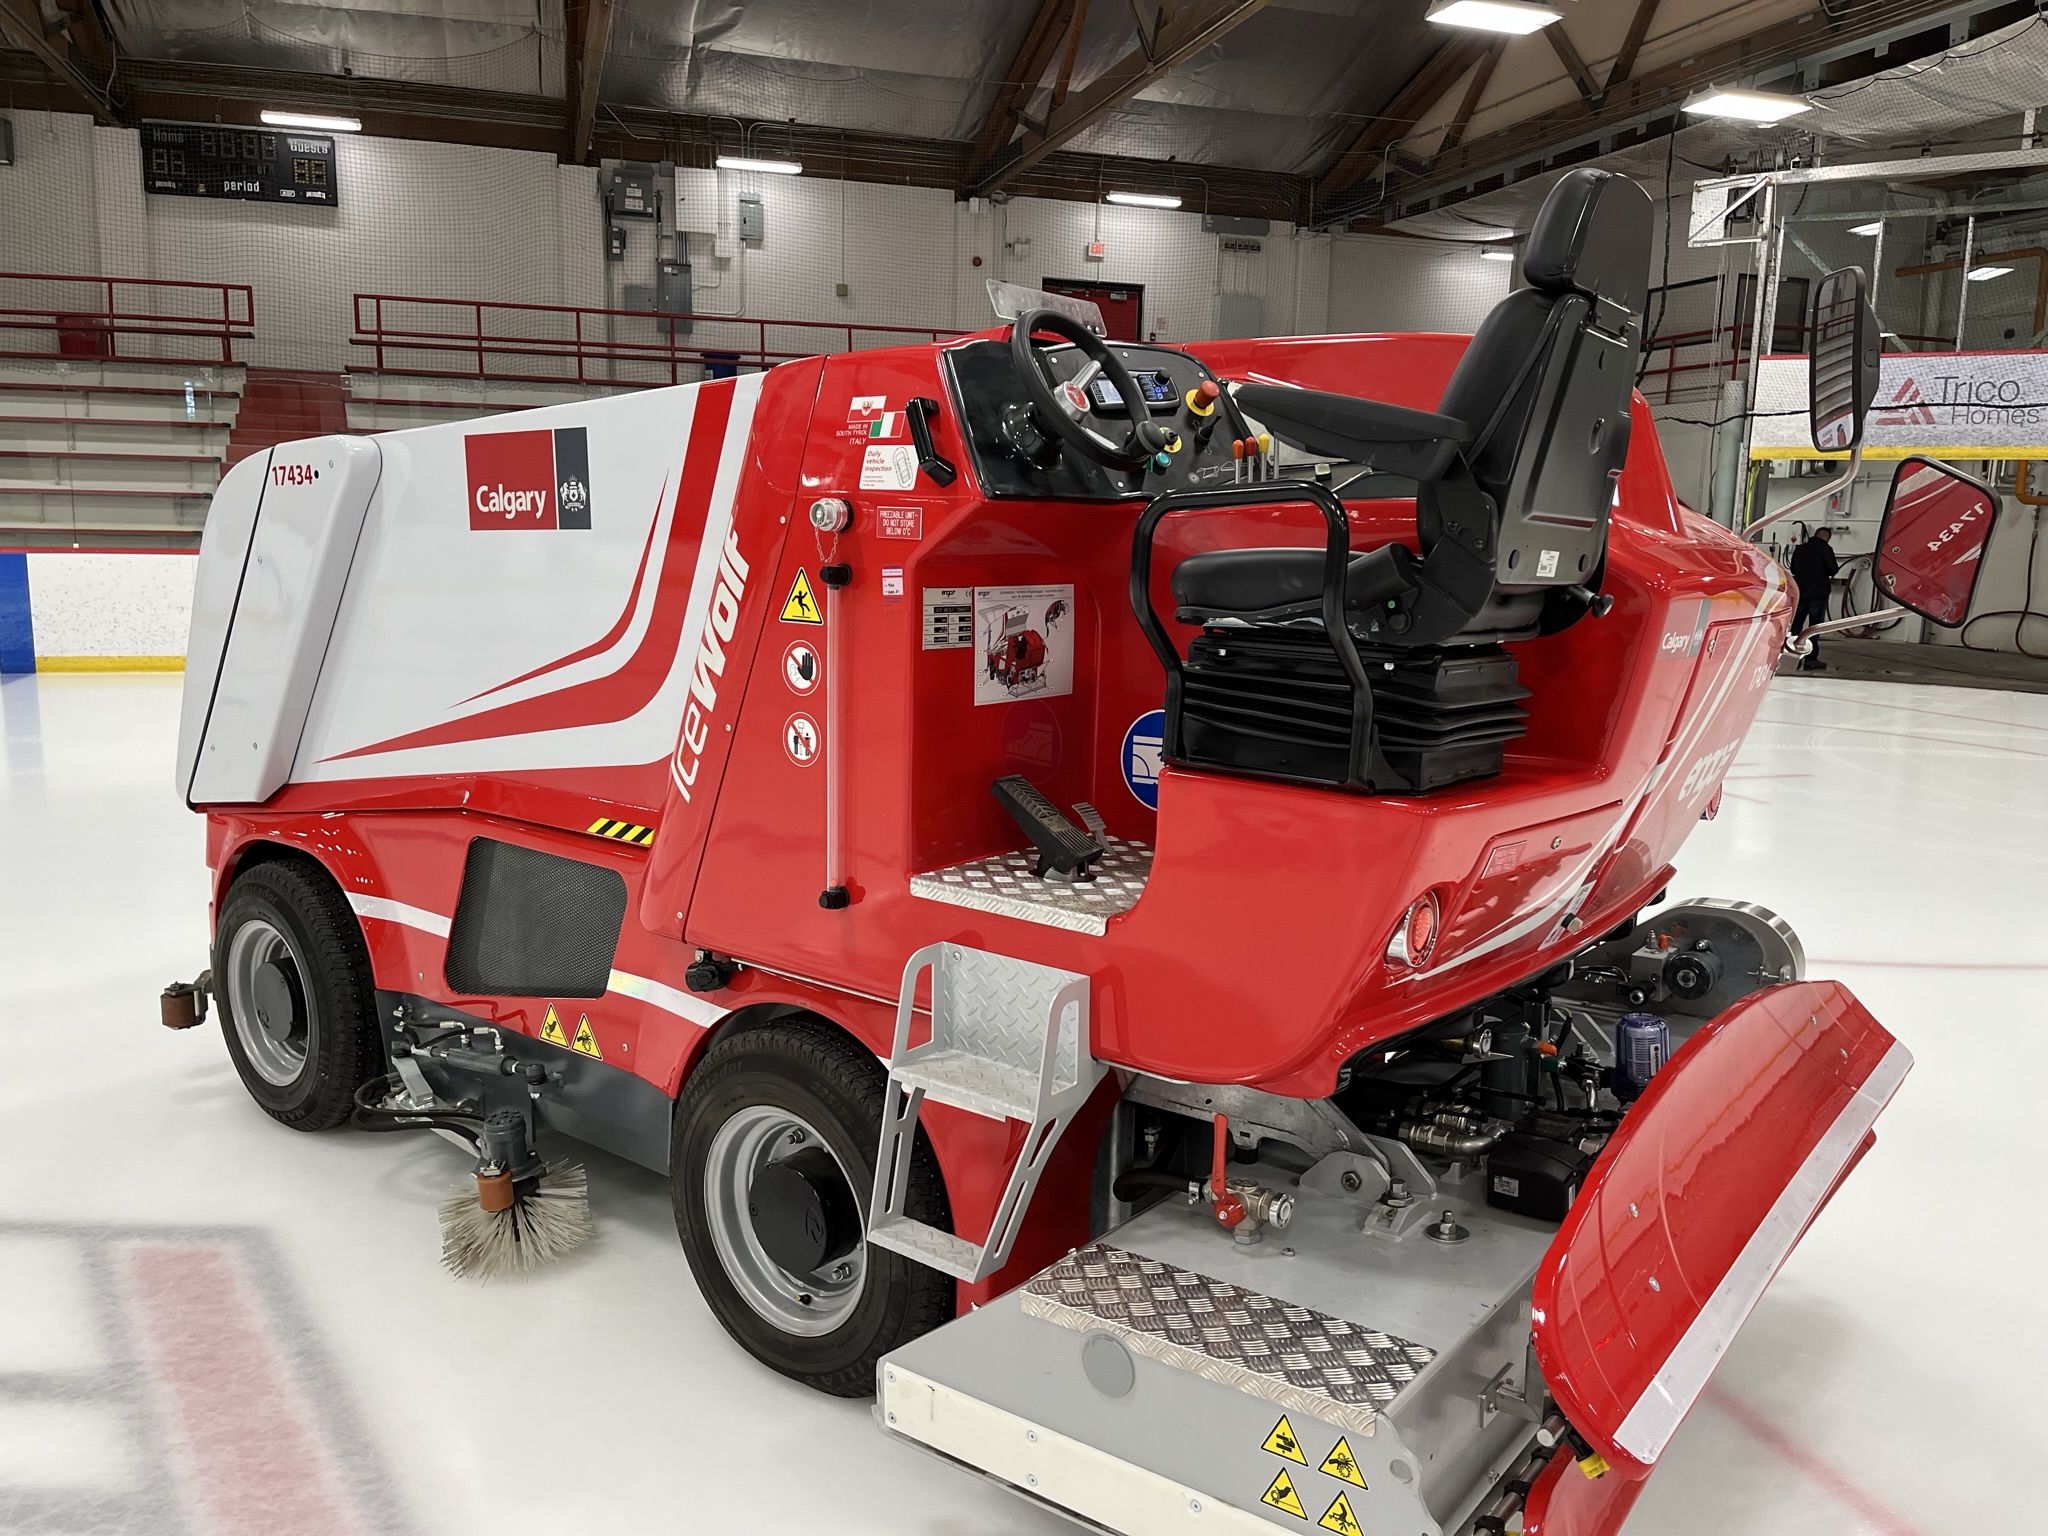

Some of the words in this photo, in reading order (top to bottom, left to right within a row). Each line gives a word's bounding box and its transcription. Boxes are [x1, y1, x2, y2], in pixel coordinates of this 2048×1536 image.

[153, 128, 184, 143] Home
[289, 140, 328, 154] Guests
[224, 180, 260, 193] period
[1935, 375, 2020, 404] Trico
[1952, 404, 2040, 425] Homes
[867, 450, 882, 458] Daily
[272, 464, 313, 486] 17434
[864, 465, 892, 473] inspection
[475, 483, 547, 520] Calgary
[880, 510, 904, 519] FREEZABLE
[882, 519, 890, 527] DO
[890, 519, 899, 527] NOT
[900, 520, 915, 528] STORE
[886, 527, 901, 535] BELOW
[1662, 631, 1691, 654] Calgary
